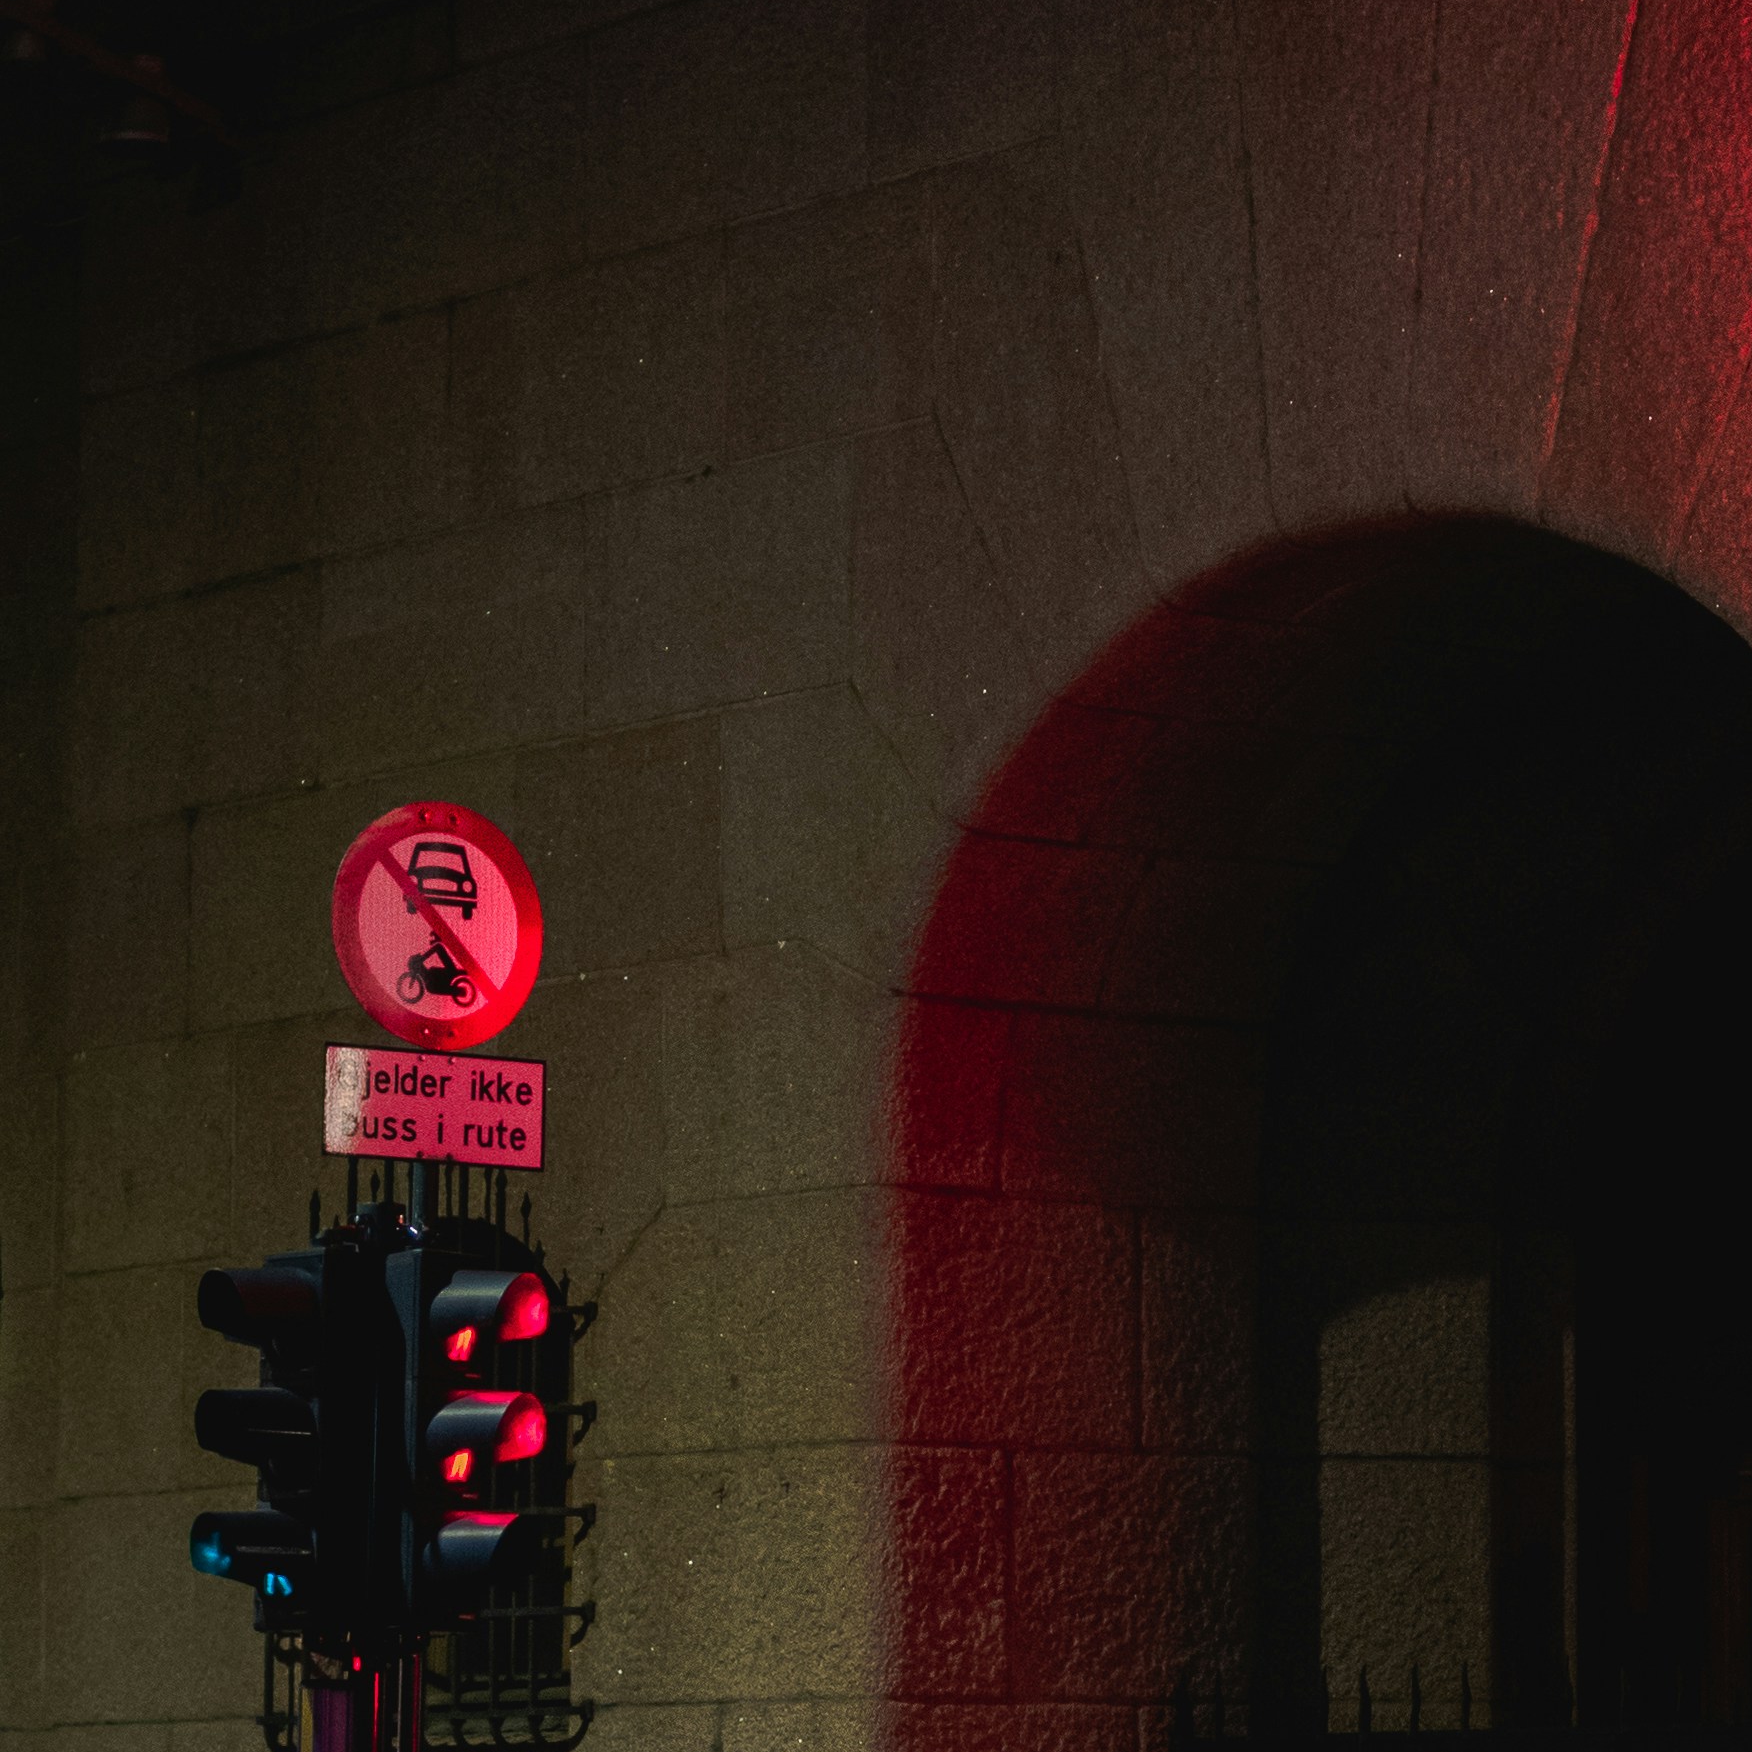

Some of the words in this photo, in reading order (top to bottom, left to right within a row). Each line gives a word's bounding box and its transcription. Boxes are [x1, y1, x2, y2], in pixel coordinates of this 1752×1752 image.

[338, 1060, 451, 1101] jelder
[470, 1069, 533, 1106] ikke
[436, 1113, 444, 1145] i
[462, 1118, 527, 1151] rute
